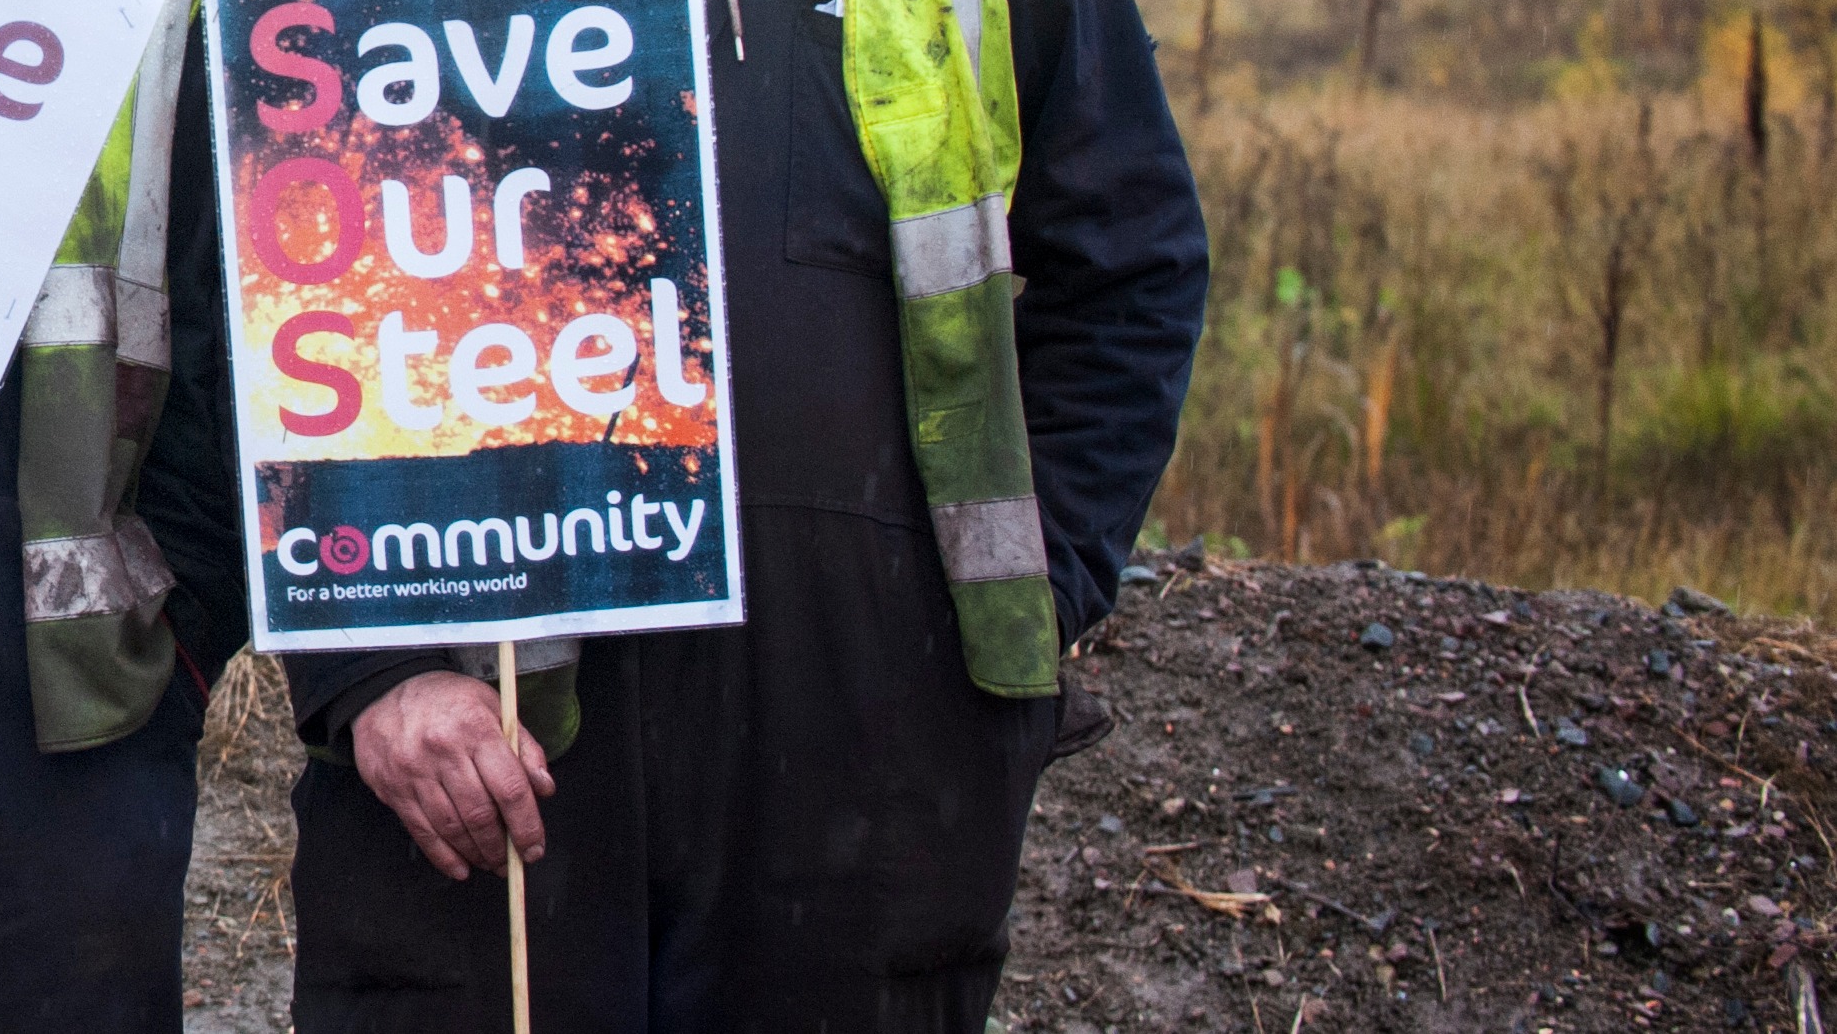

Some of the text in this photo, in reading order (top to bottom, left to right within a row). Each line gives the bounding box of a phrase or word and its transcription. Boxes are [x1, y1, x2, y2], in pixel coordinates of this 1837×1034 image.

[249, 1, 634, 134] Save
[252, 157, 552, 285] Our
[271, 277, 707, 438] Steel
[277, 489, 705, 576] community
[287, 572, 527, 602] For a better working world
